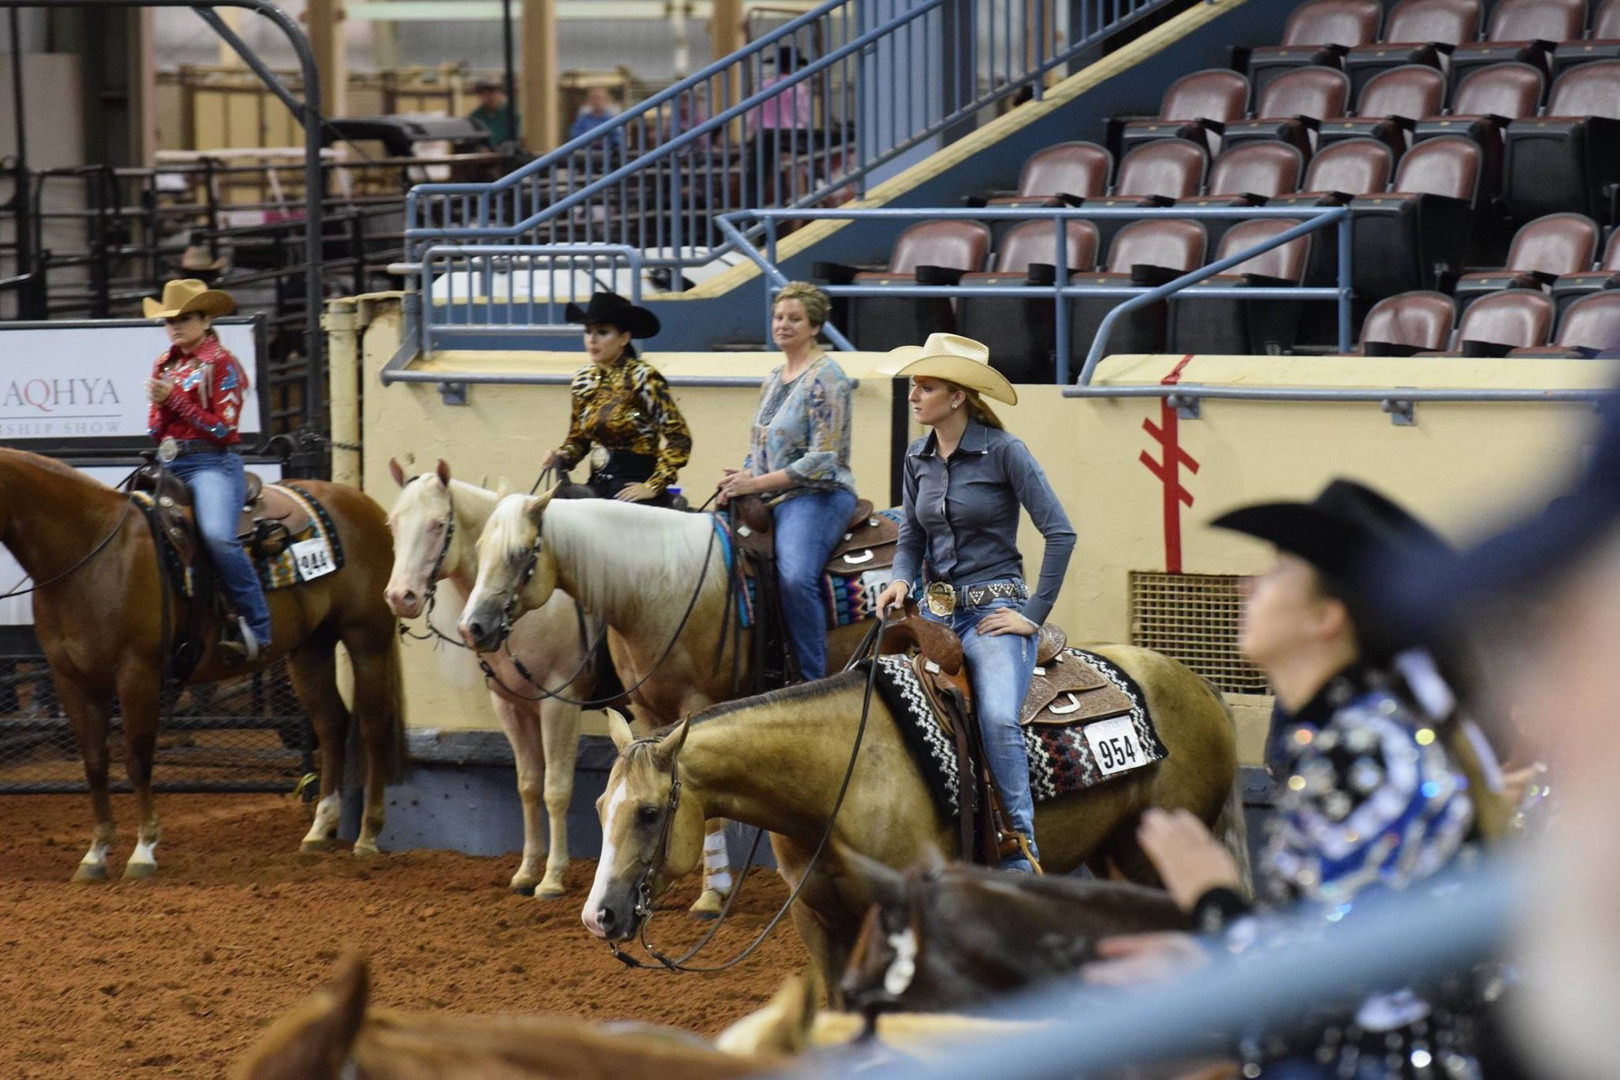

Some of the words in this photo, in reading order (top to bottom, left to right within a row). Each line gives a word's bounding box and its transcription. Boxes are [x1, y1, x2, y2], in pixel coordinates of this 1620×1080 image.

[2, 378, 121, 412] AQHYA
[0, 423, 54, 435] SHIP
[63, 421, 121, 433] SHOW
[1098, 735, 1136, 769] 954
